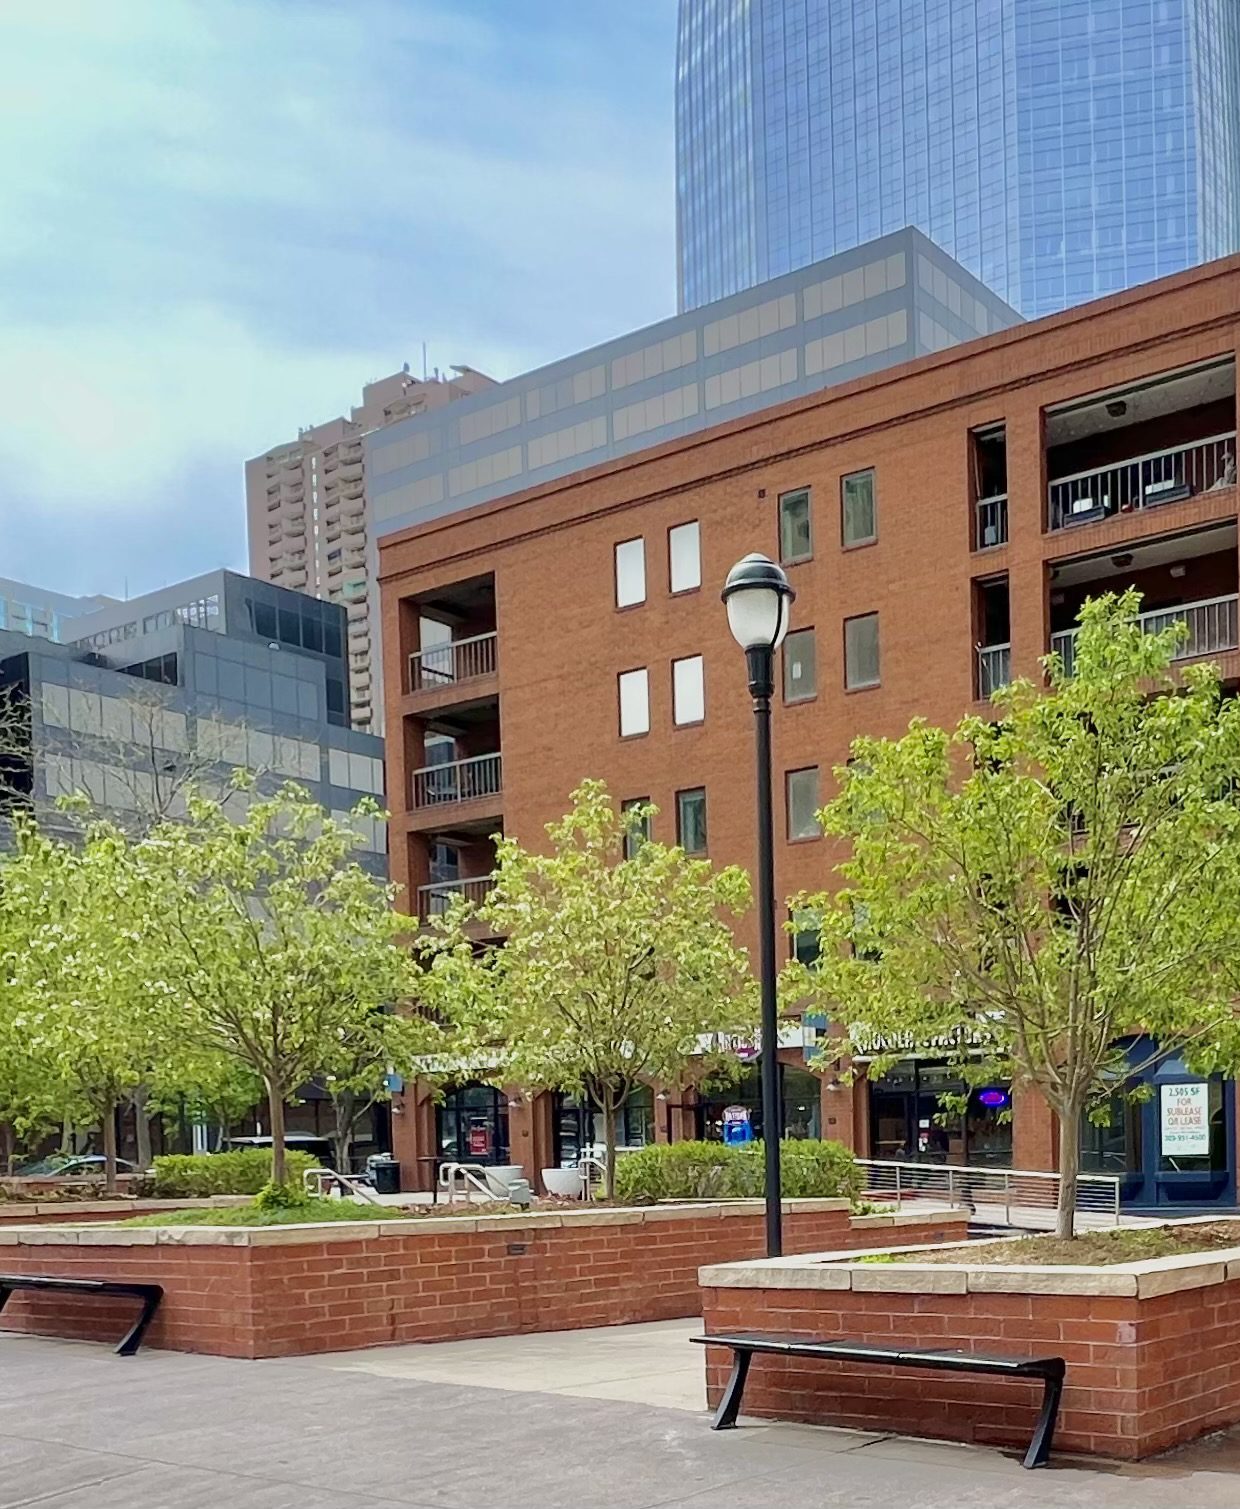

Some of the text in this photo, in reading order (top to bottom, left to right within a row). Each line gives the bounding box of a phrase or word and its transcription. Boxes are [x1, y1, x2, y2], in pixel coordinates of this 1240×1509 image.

[1177, 1098, 1192, 1106] FOR
[1167, 1107, 1201, 1116] SUBLEASE
[1168, 1117, 1201, 1126] OR LEASE
